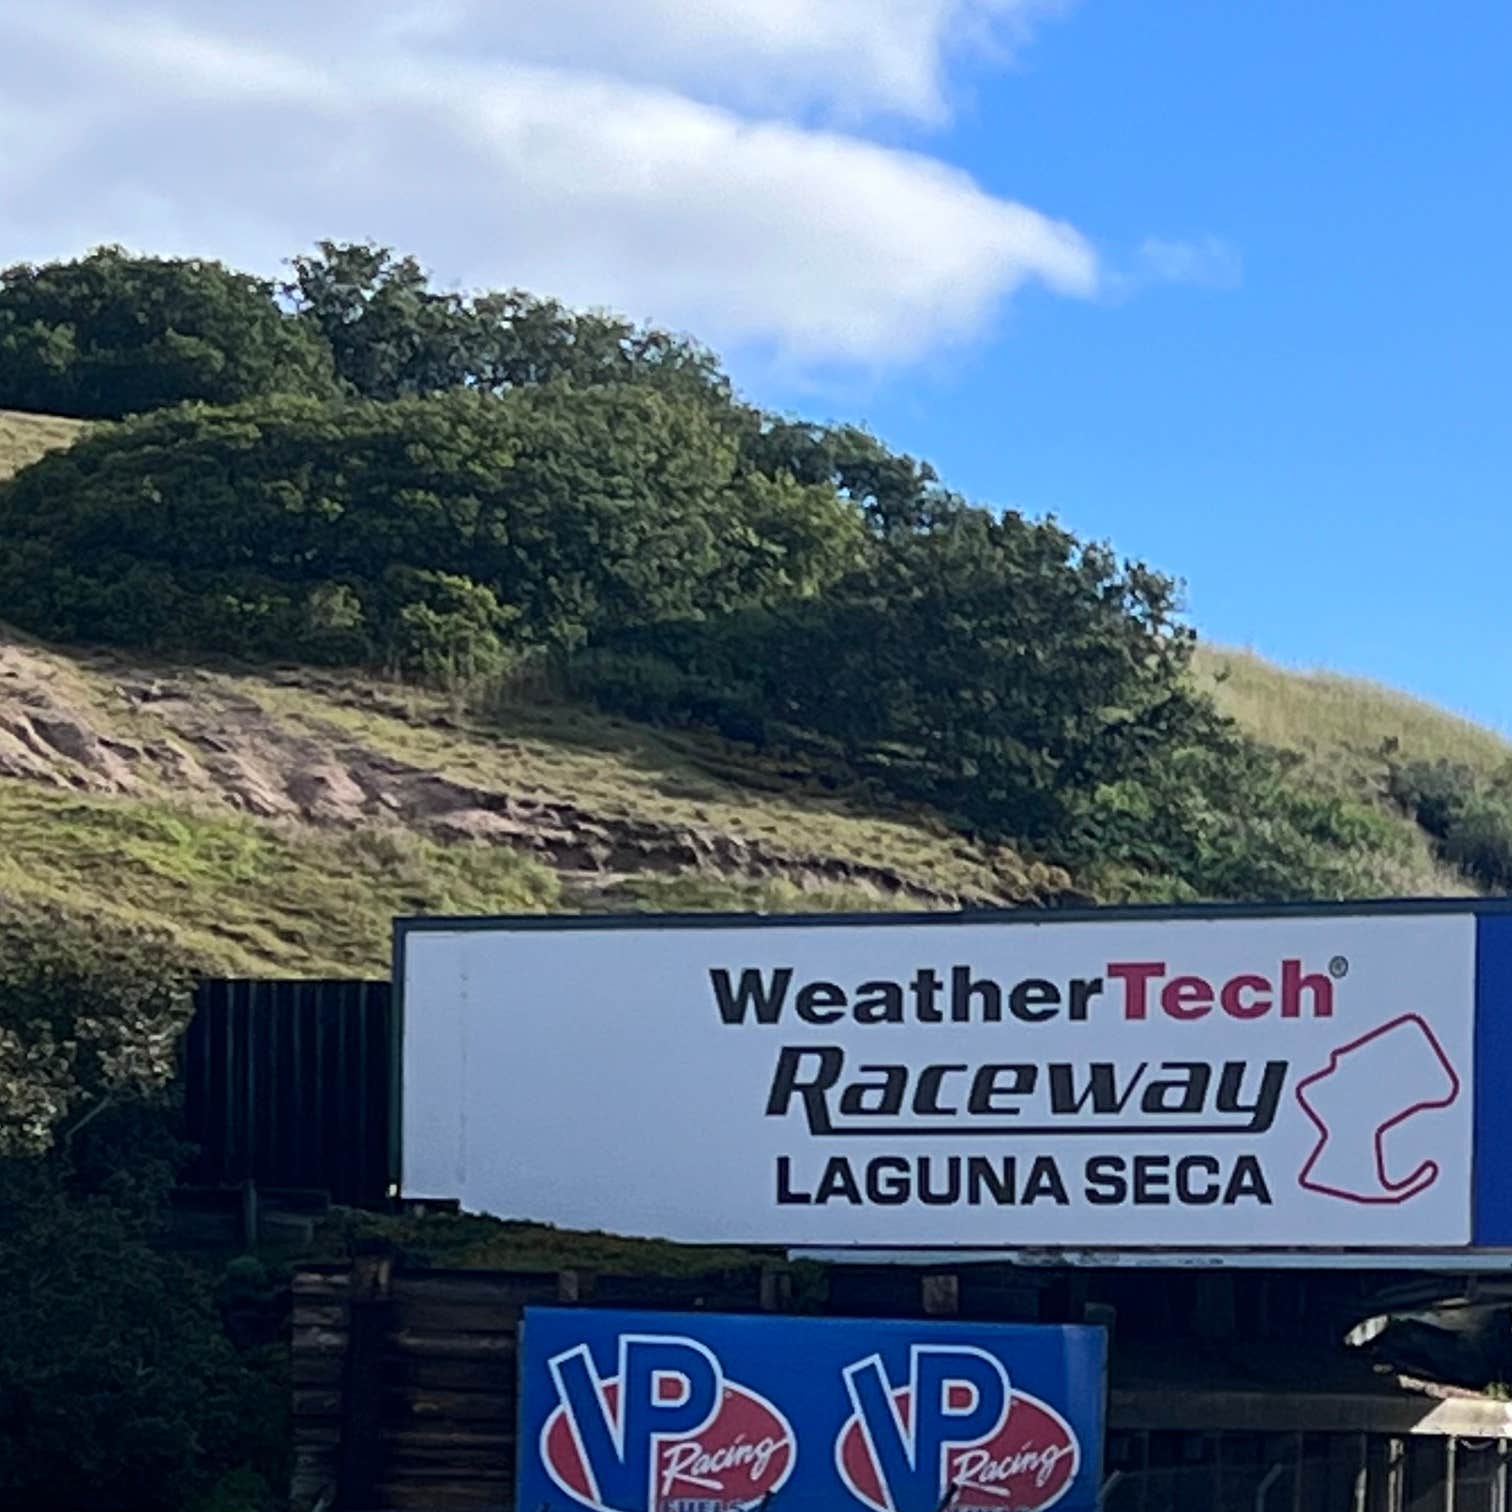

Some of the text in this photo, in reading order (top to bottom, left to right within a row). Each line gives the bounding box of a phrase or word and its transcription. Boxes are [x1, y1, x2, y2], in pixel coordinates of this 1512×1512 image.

[765, 1045, 1289, 1136] Raceway
[775, 1154, 1273, 1206] LAGUNA SECA
[661, 1433, 790, 1496] Racing
[952, 1440, 1074, 1504] Racing
